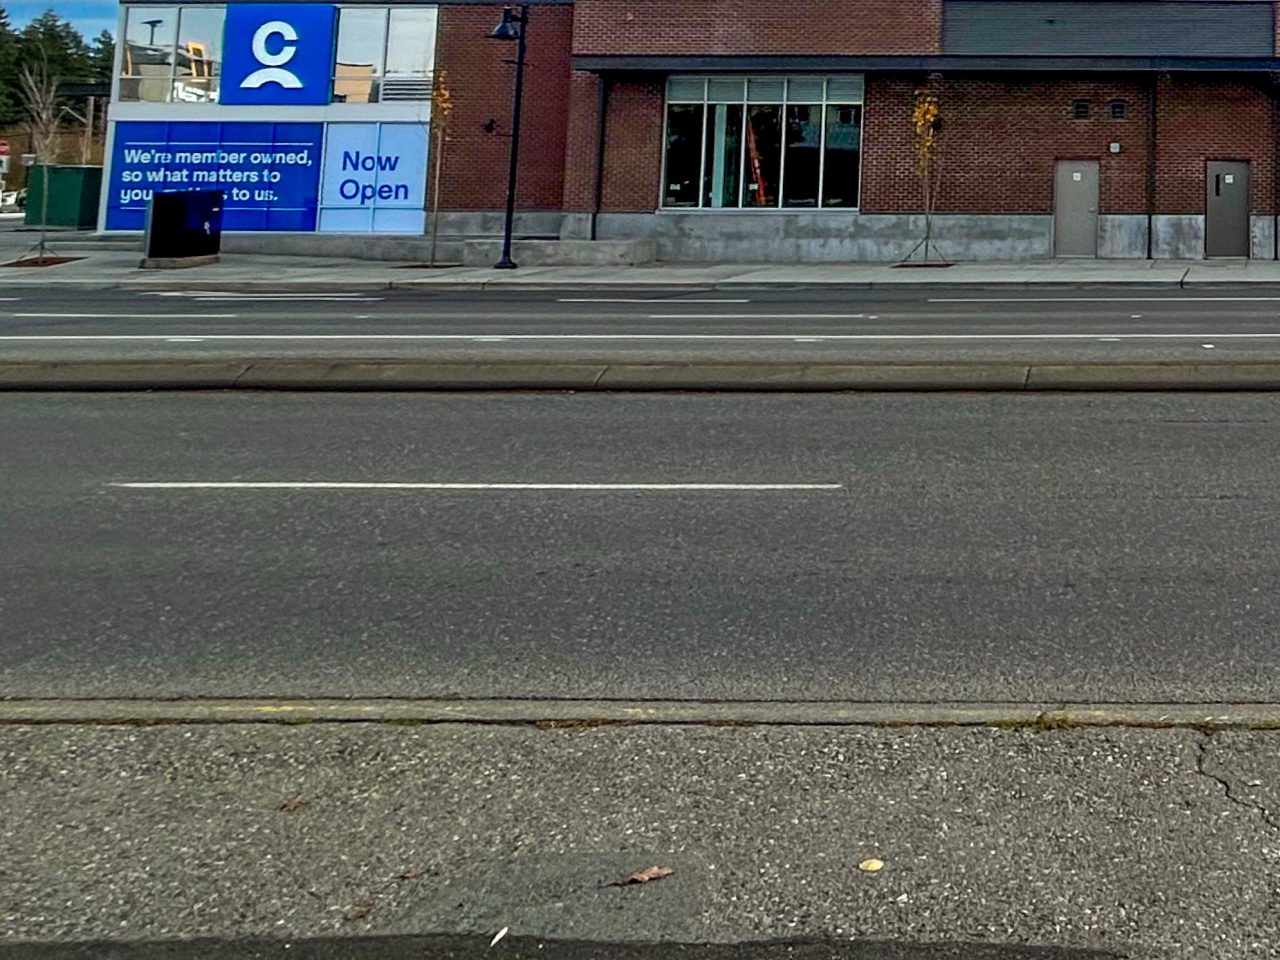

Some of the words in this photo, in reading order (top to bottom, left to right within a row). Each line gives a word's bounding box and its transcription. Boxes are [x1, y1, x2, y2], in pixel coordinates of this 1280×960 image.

[124, 149, 172, 165] We're
[175, 149, 247, 165] member
[249, 149, 313, 167] owned,
[342, 150, 400, 172] Now
[121, 170, 143, 183] so
[146, 168, 190, 183] what
[192, 169, 259, 183] matters
[263, 169, 281, 183] to
[120, 189, 153, 204] you
[232, 188, 250, 201] to
[254, 189, 279, 201] us.
[339, 178, 409, 206] Open
